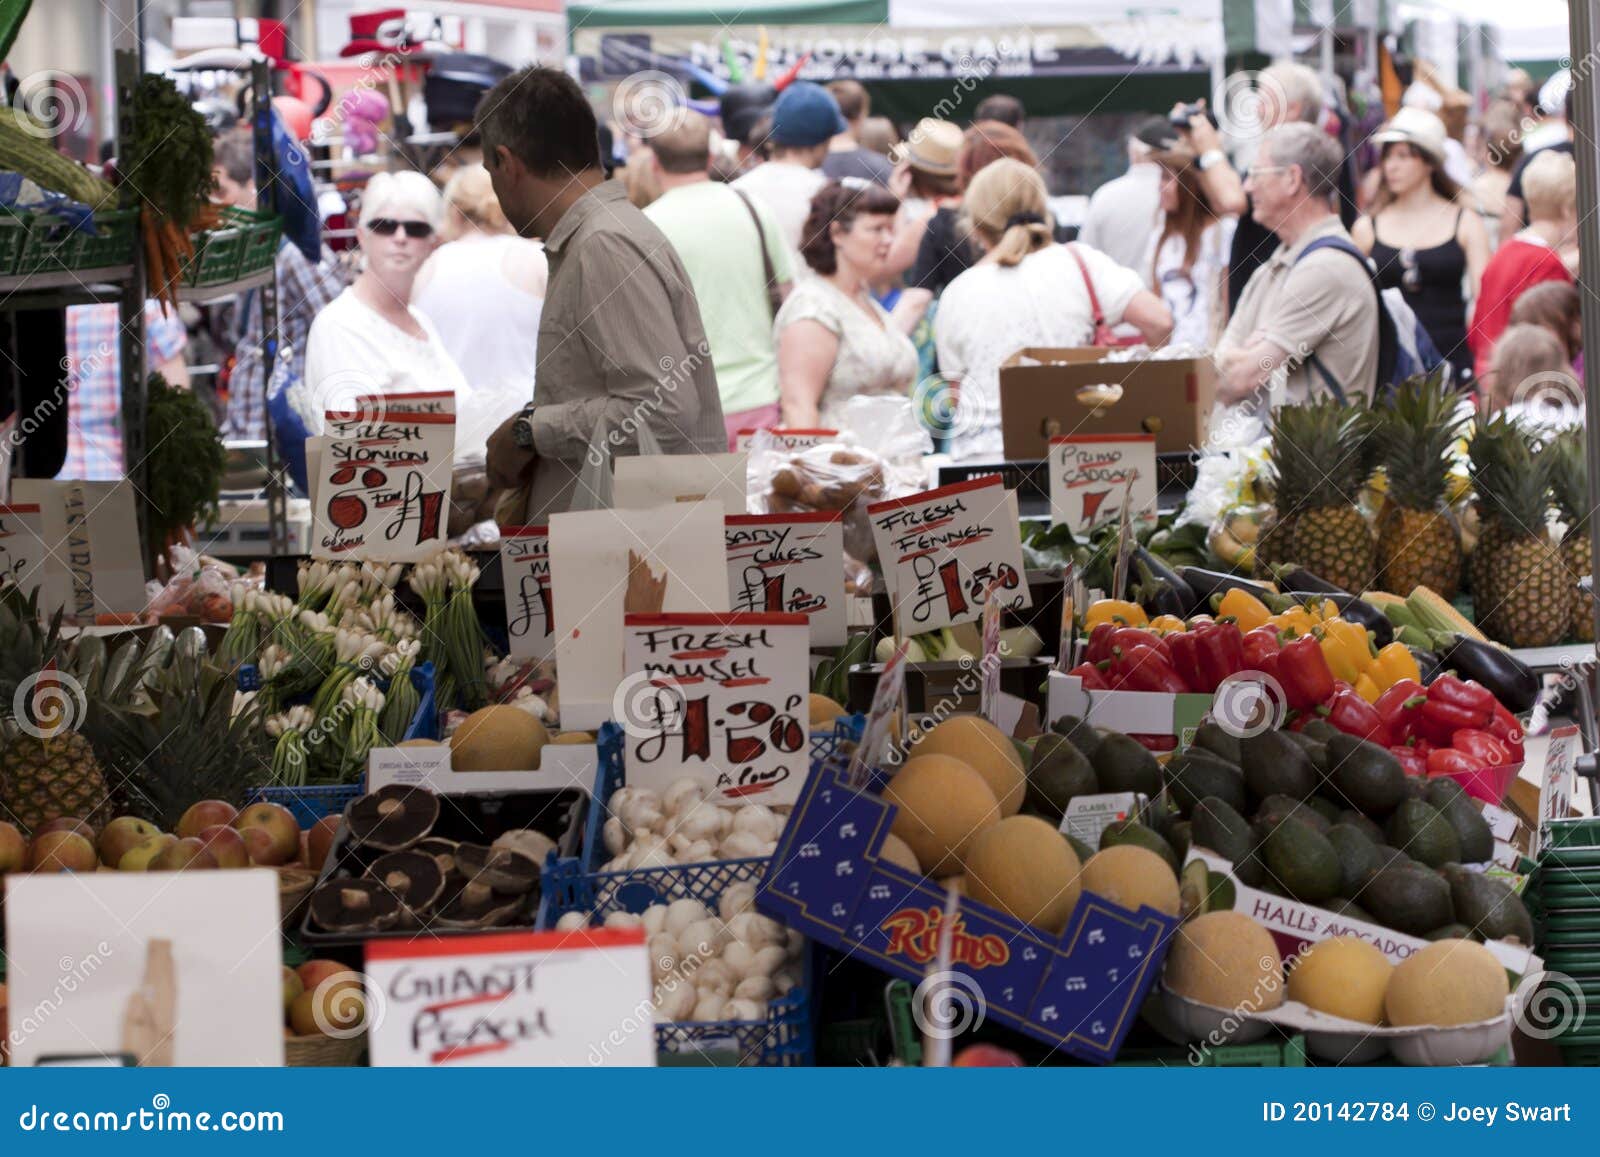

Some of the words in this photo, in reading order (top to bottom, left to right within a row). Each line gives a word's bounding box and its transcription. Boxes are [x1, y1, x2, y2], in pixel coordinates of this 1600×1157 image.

[332, 419, 424, 441] FRESH
[1061, 445, 1122, 465] PRIMO
[876, 499, 967, 531] FRESH
[895, 525, 994, 552] FENNEL
[635, 627, 774, 653] FRESH
[1253, 900, 1319, 932] HALLS
[881, 906, 1010, 970] Ritmo
[390, 965, 537, 1002] GIANT
[411, 1008, 553, 1050] PEACH
